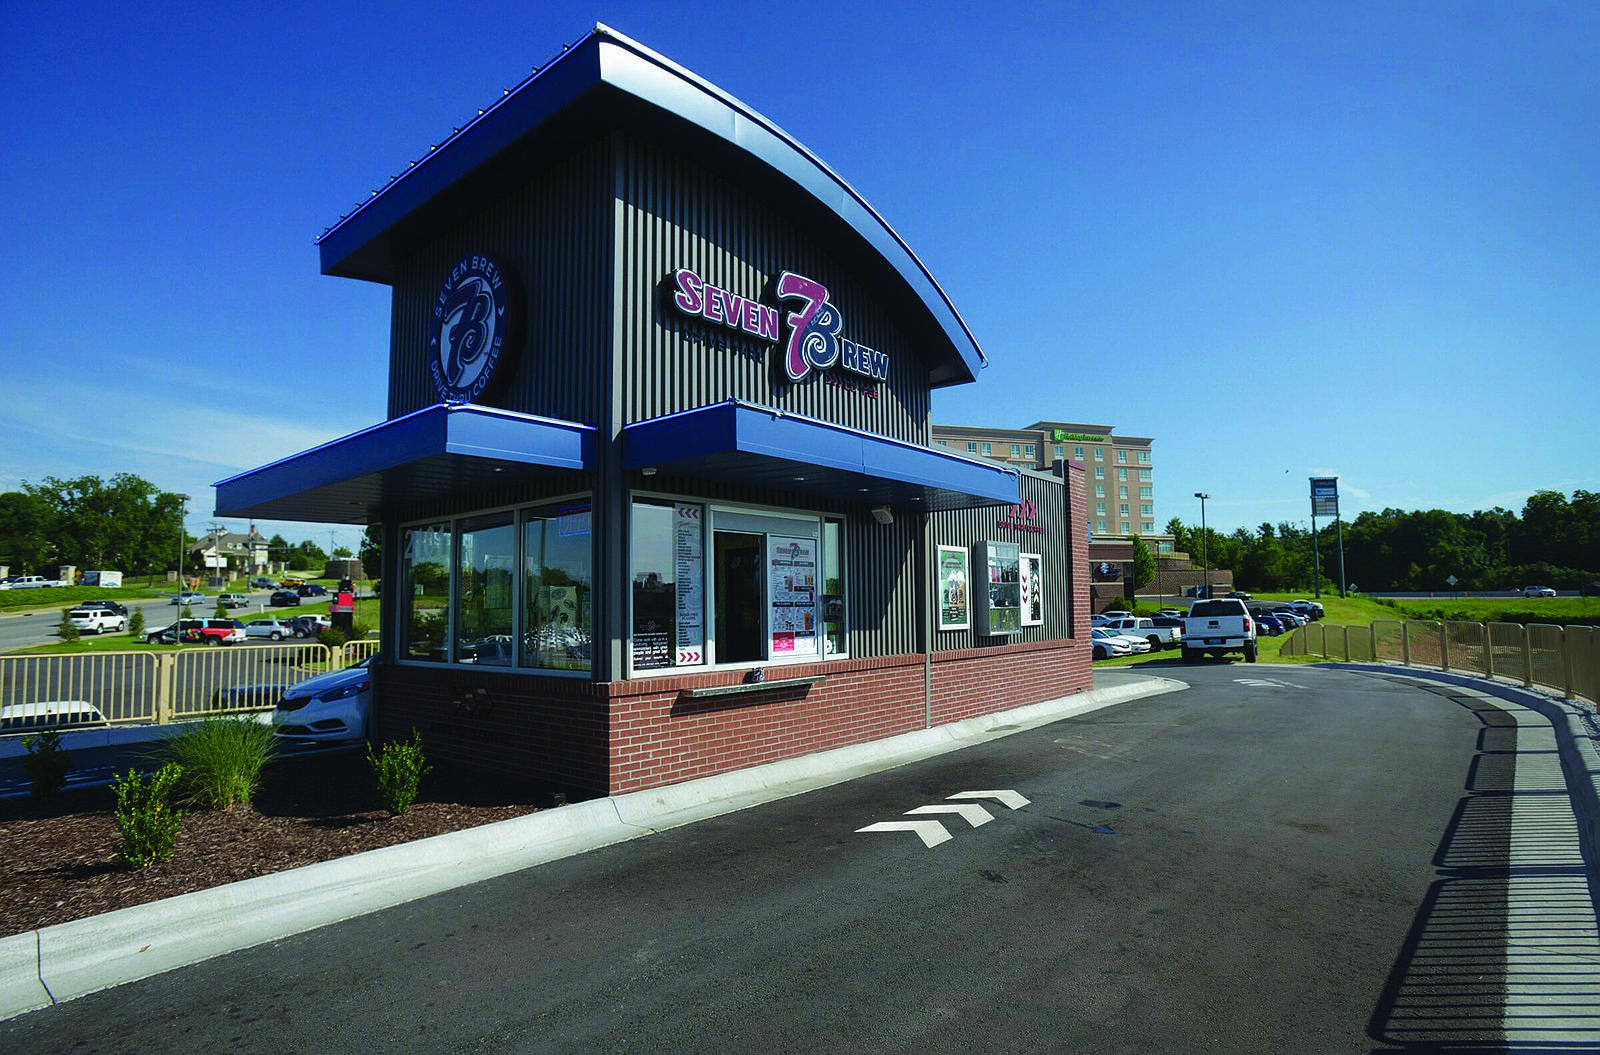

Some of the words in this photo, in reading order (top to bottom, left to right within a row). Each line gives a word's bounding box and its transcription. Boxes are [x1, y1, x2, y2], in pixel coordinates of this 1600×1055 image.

[434, 259, 467, 318] SEVEN
[471, 256, 502, 290] BREW
[673, 268, 780, 344] SEVEN
[430, 359, 448, 400] DRIVE
[472, 335, 503, 397] COFFEE
[682, 328, 726, 352] DRIVE
